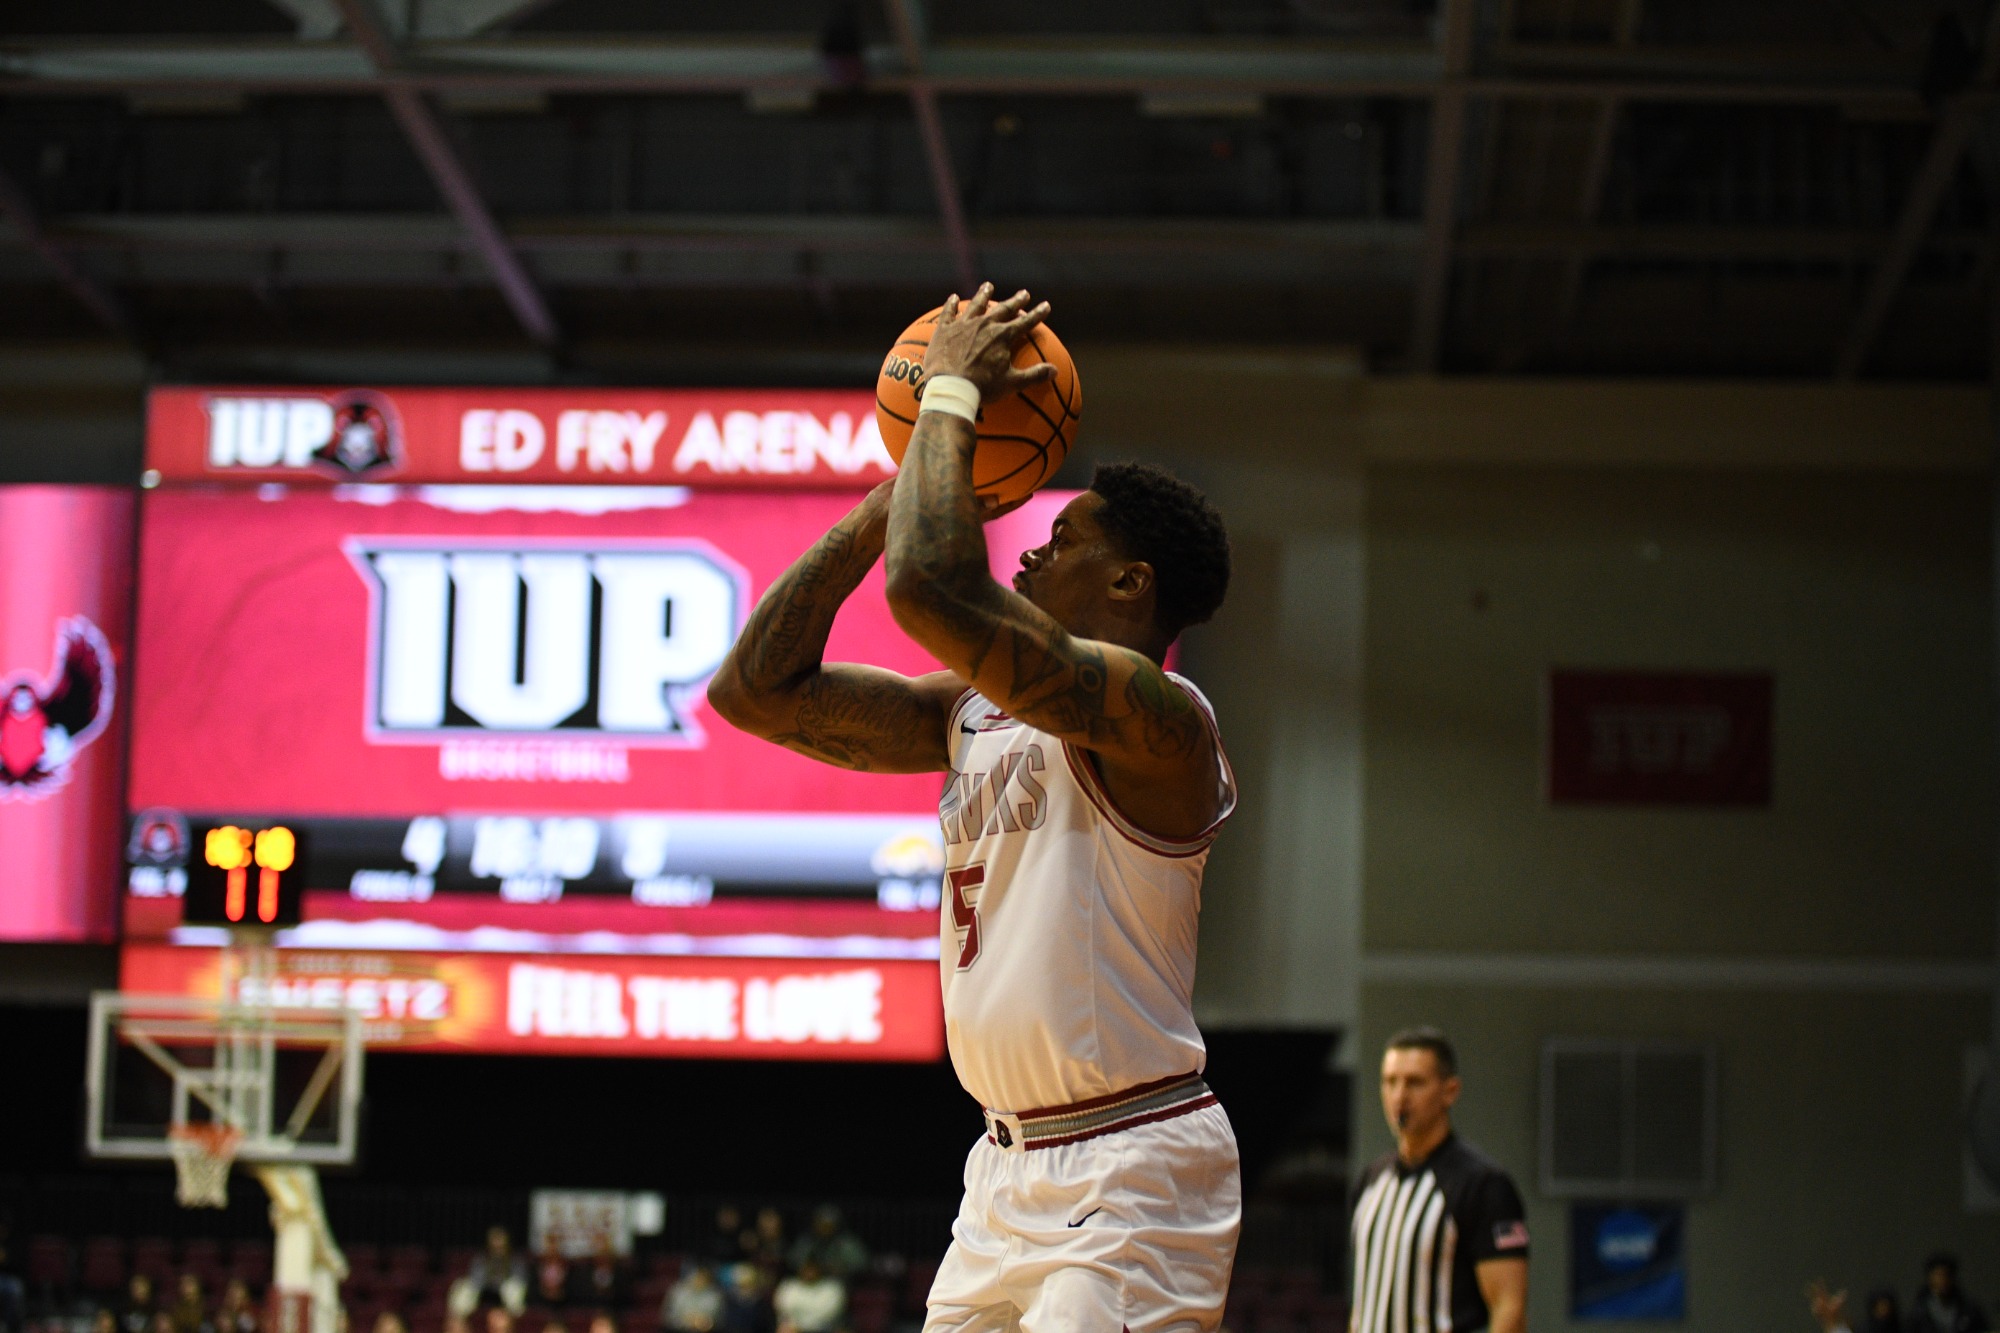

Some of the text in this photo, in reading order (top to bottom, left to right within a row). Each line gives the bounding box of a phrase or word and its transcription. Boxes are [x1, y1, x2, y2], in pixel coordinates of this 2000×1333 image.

[210, 397, 335, 468] IUP
[459, 408, 900, 475] ED FRY ARENA
[370, 550, 738, 733] IUP
[439, 741, 630, 782] BASKETBALL
[947, 861, 988, 973] 5
[507, 961, 883, 1043] FEEL THE LOVE
